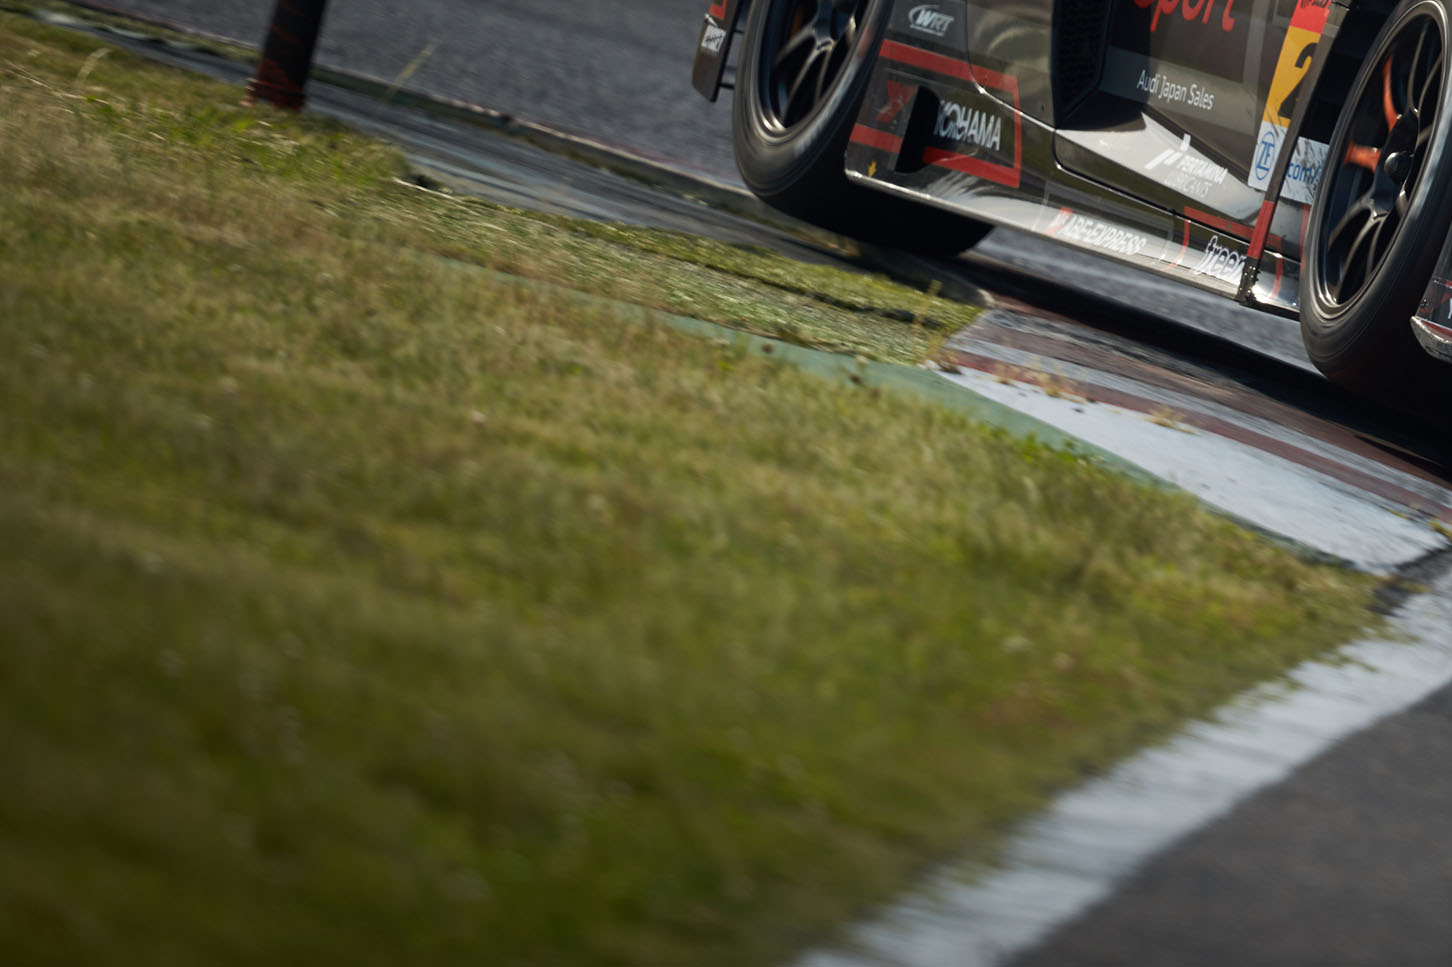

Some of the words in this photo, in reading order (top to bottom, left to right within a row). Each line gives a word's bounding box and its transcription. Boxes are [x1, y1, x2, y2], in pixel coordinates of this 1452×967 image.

[1136, 69, 1160, 98] Audi
[1158, 76, 1187, 103] Japan
[1187, 83, 1215, 110] Sales
